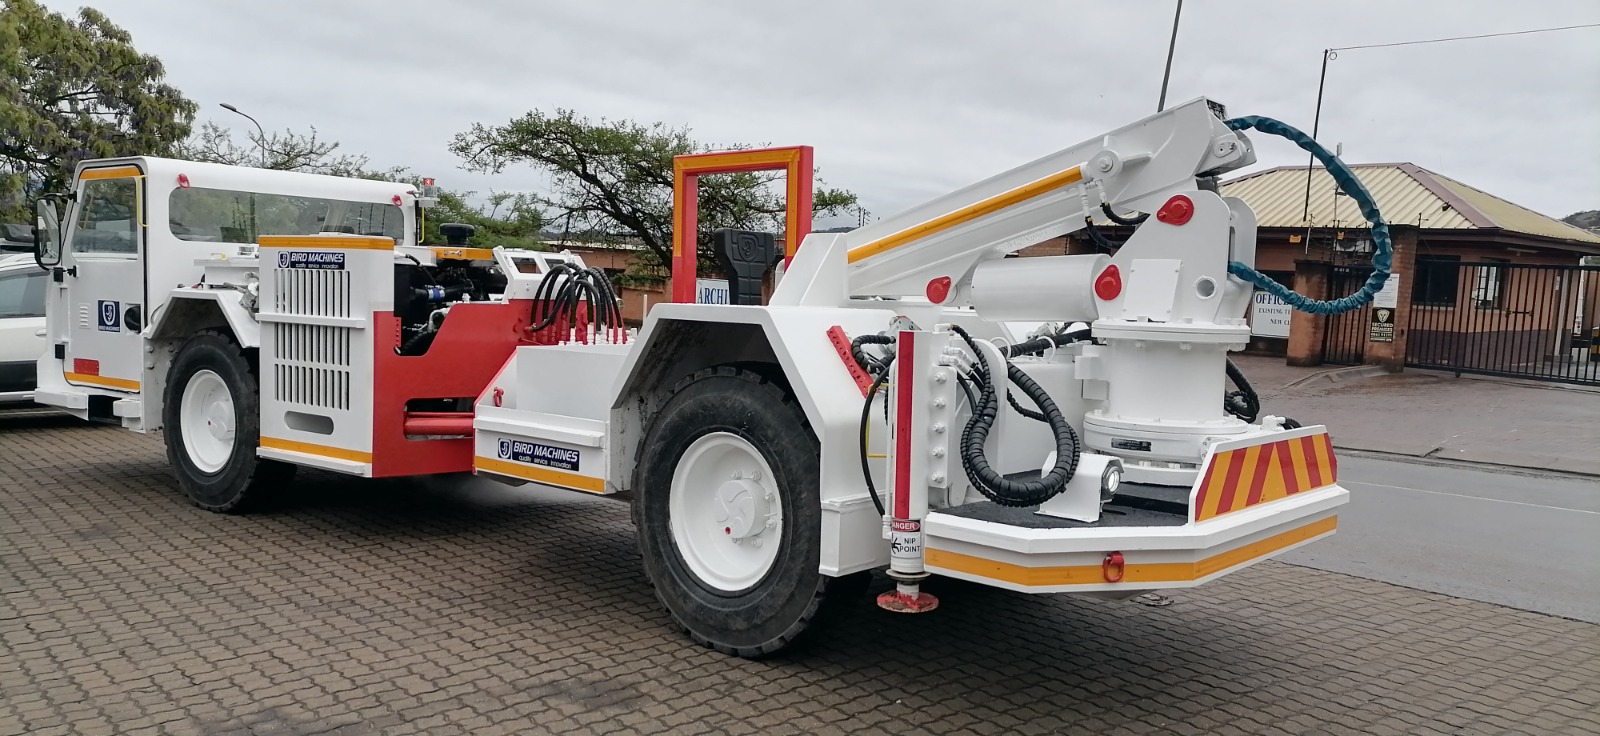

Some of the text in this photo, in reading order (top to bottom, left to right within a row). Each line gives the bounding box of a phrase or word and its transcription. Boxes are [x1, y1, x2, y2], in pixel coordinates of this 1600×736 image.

[291, 252, 344, 262] BIRD MACHINES
[1258, 307, 1283, 315] EXISTING
[513, 442, 579, 462] BIRD MACHINES
[533, 458, 549, 466] service
[892, 521, 916, 530] ANGER
[903, 537, 916, 545] NIP
[899, 545, 920, 553] POINT
